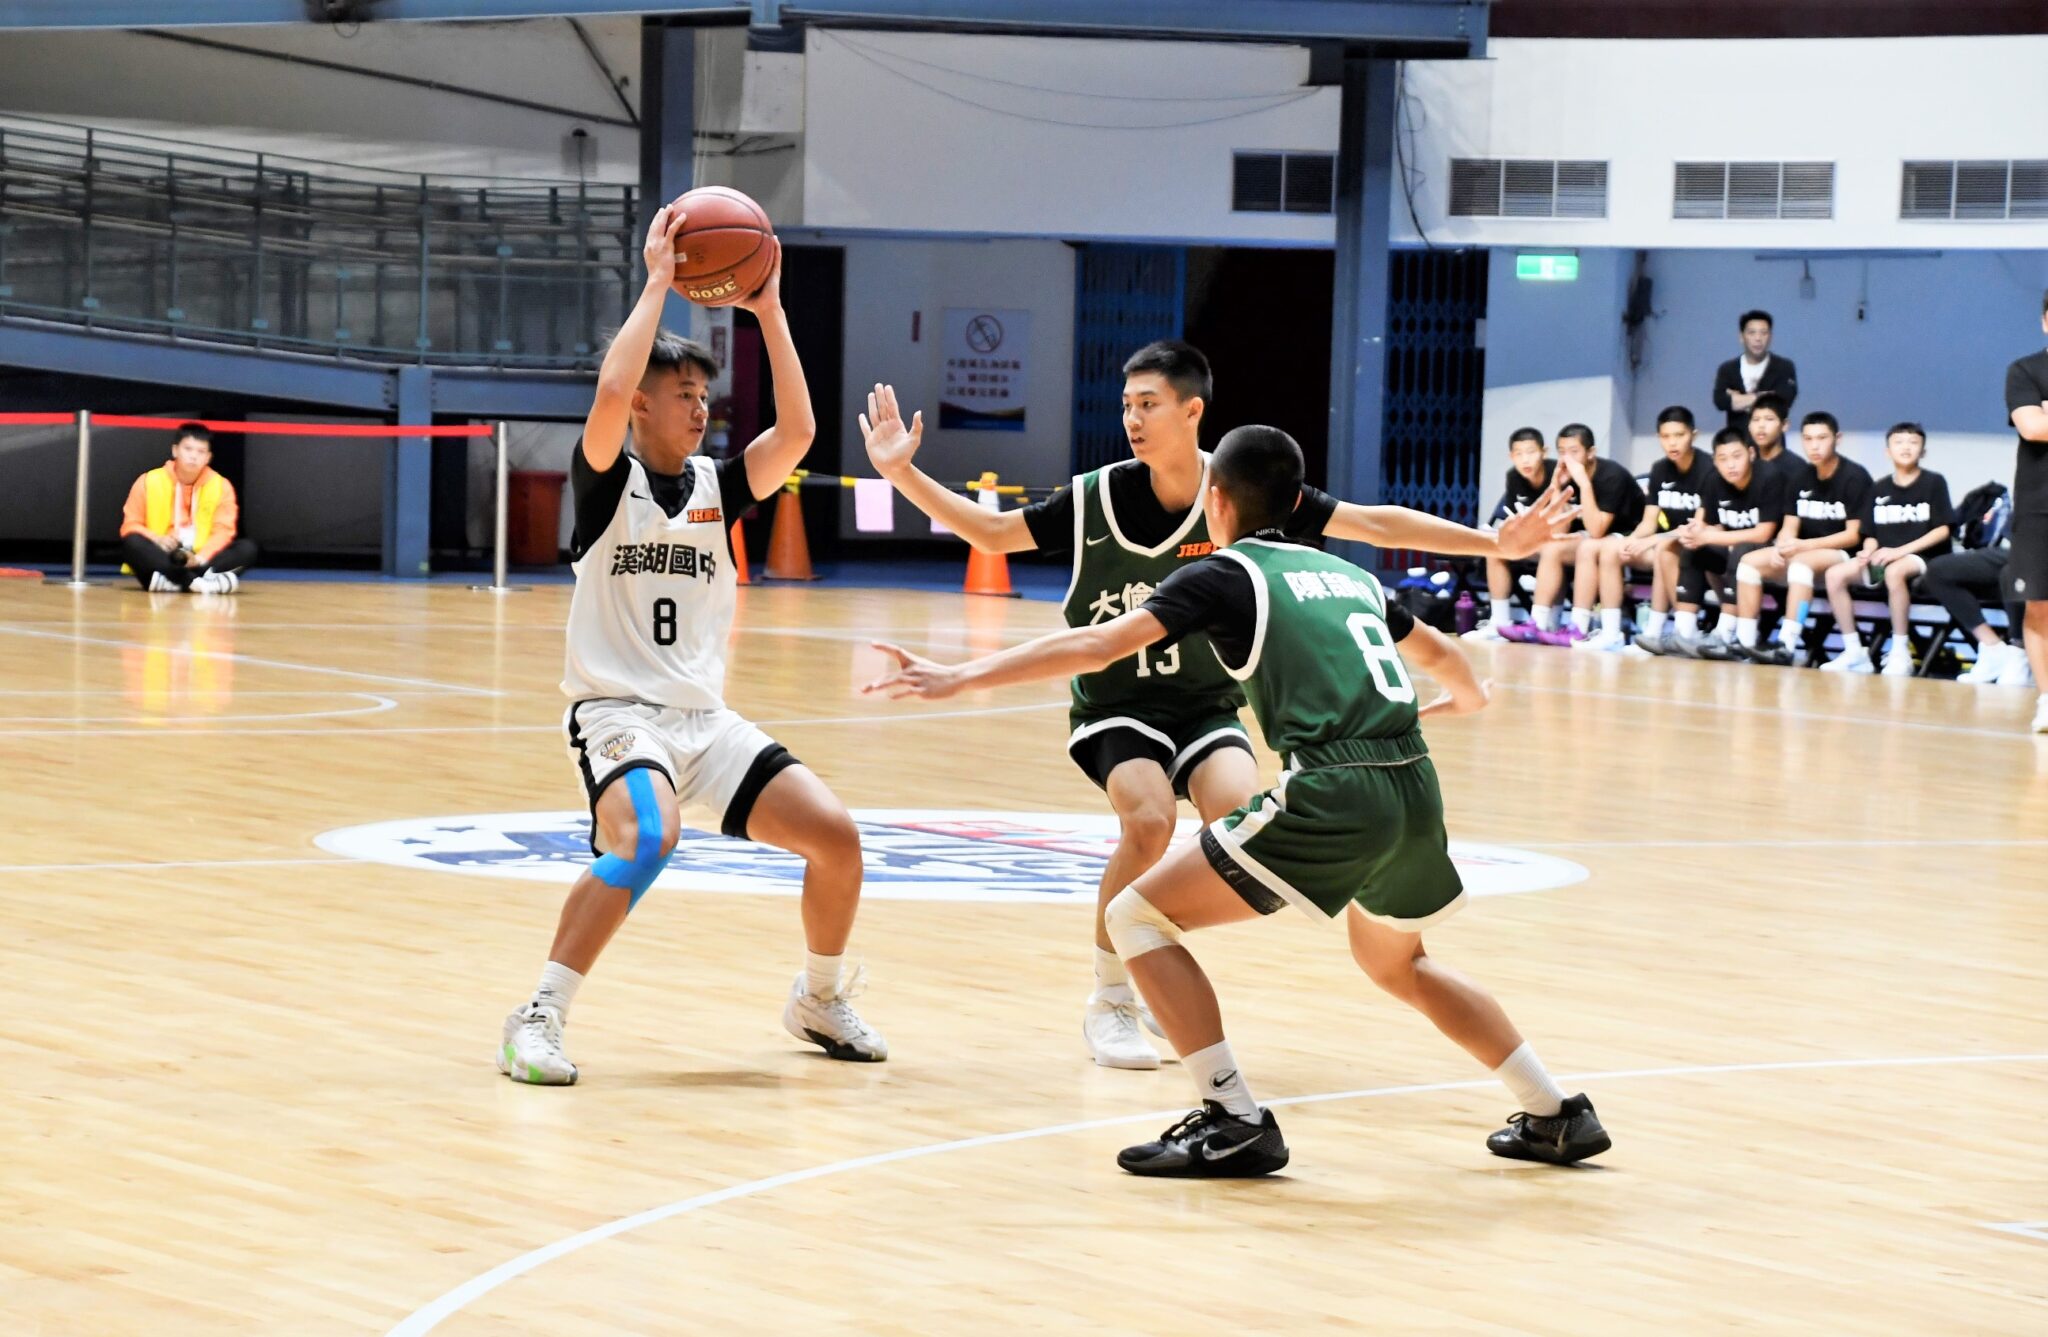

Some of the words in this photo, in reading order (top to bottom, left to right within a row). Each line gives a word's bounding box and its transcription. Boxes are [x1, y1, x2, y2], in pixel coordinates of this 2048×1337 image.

[689, 281, 737, 298] 3600
[611, 543, 717, 584] 溪湖國中
[653, 598, 677, 645] 8
[1089, 581, 1162, 625] 大倫
[1136, 642, 1181, 677] 13
[1346, 613, 1415, 704] 8
